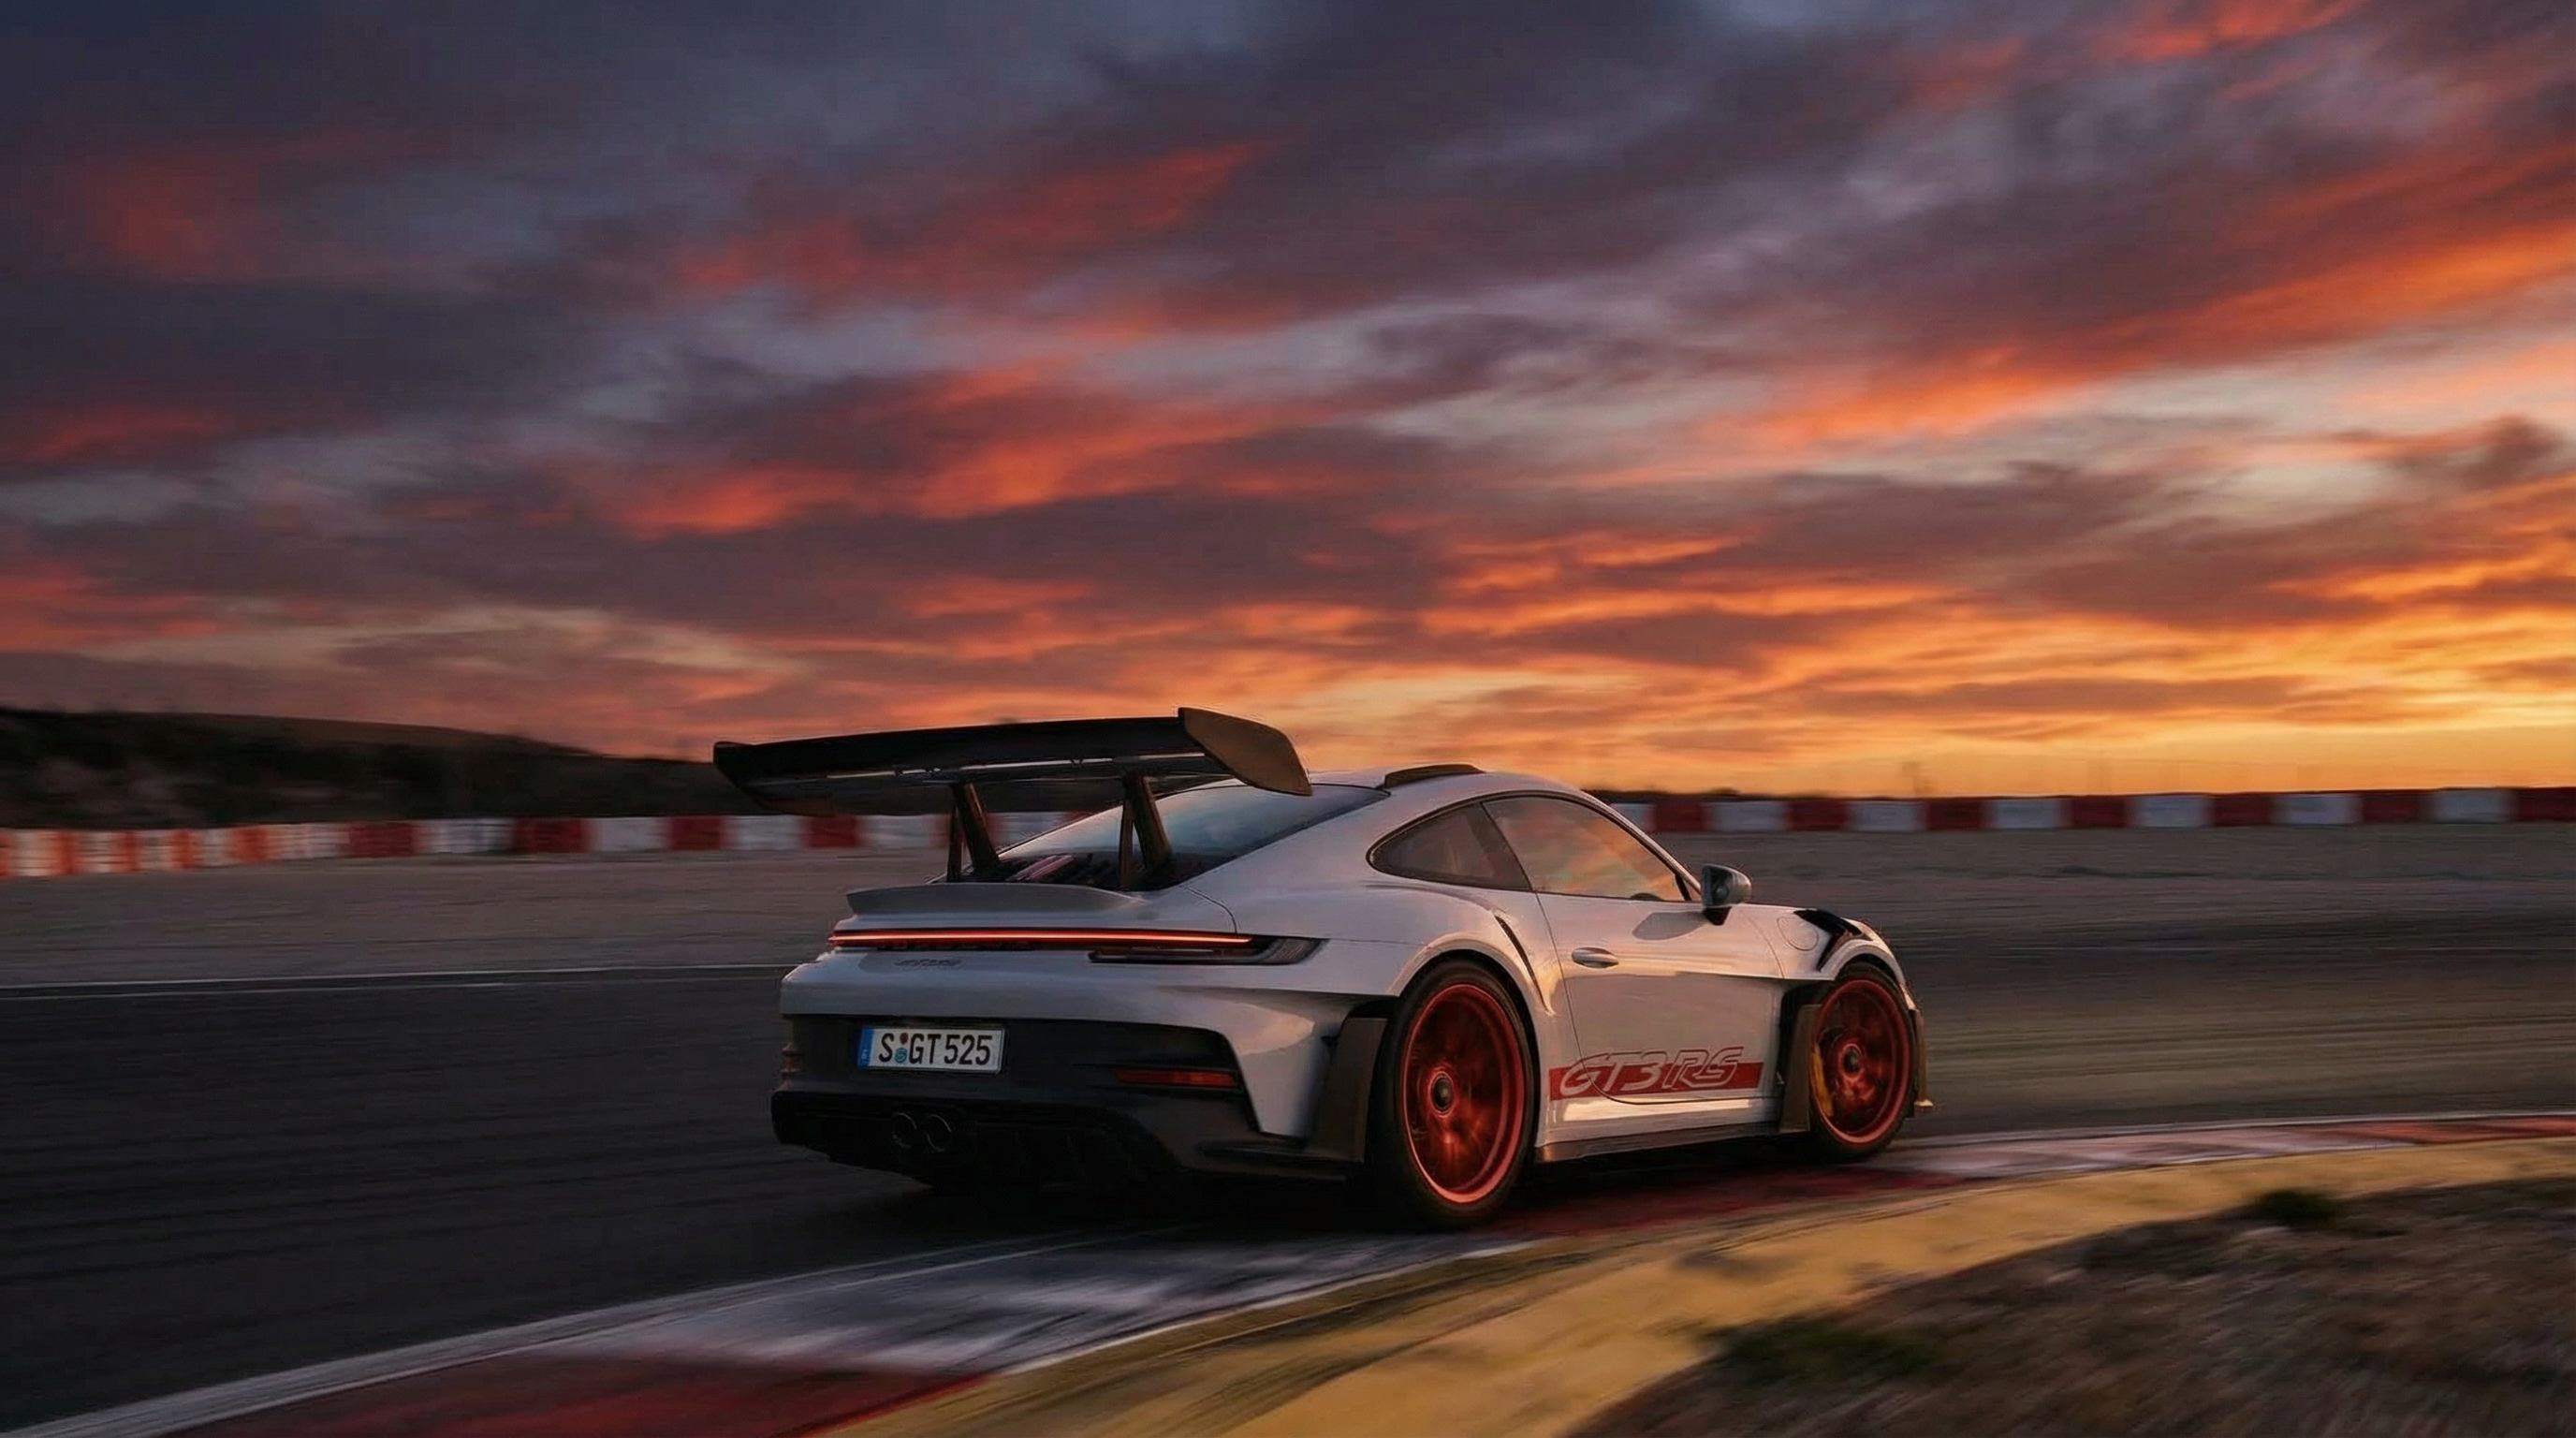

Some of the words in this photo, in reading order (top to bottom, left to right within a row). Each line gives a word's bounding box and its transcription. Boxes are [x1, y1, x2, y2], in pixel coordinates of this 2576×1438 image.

[879, 1033, 895, 1063] S
[909, 1033, 942, 1064] GT
[944, 1034, 993, 1065] 525
[1559, 1049, 1668, 1096] GT3
[1661, 1047, 1744, 1089] RS
